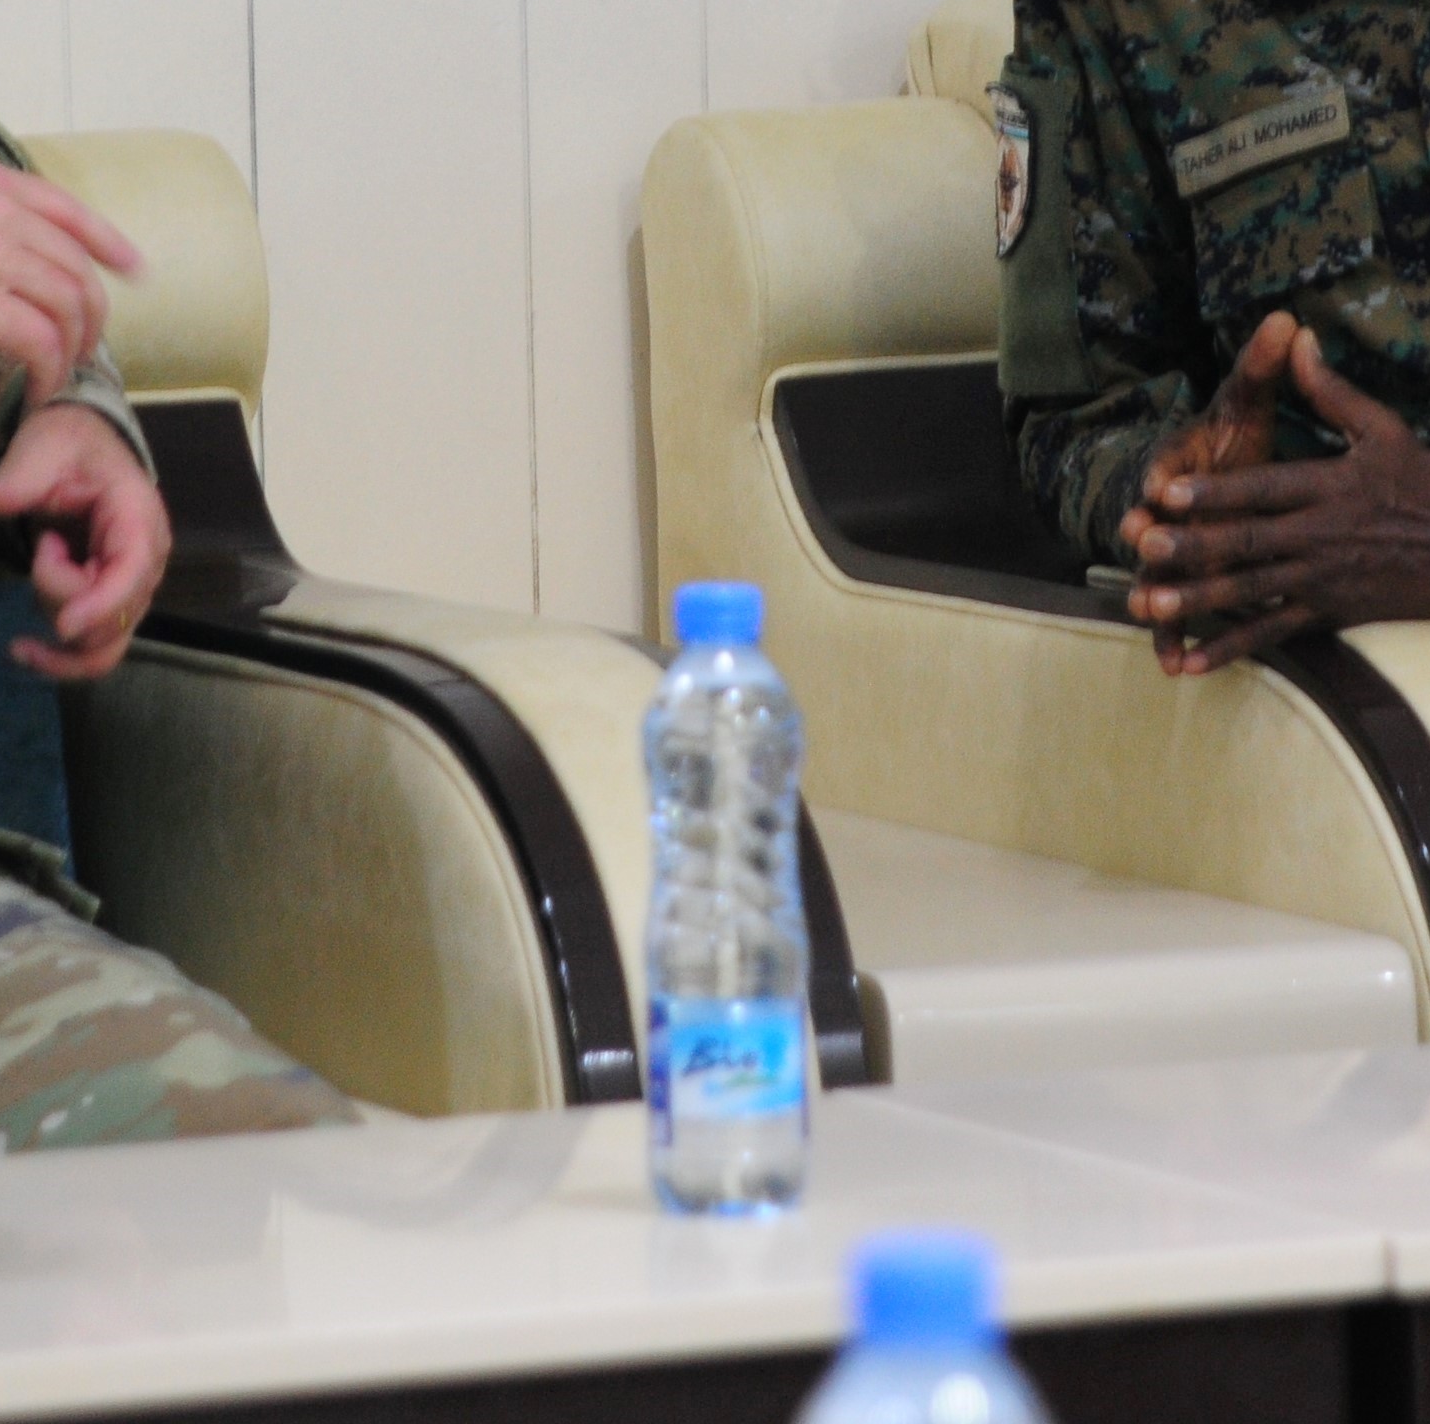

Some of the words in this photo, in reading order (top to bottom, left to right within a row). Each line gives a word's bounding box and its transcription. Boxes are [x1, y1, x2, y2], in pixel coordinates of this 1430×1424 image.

[1180, 143, 1223, 174] TAHER
[1227, 132, 1247, 156] ALI
[1253, 104, 1339, 145] MOHAMED
